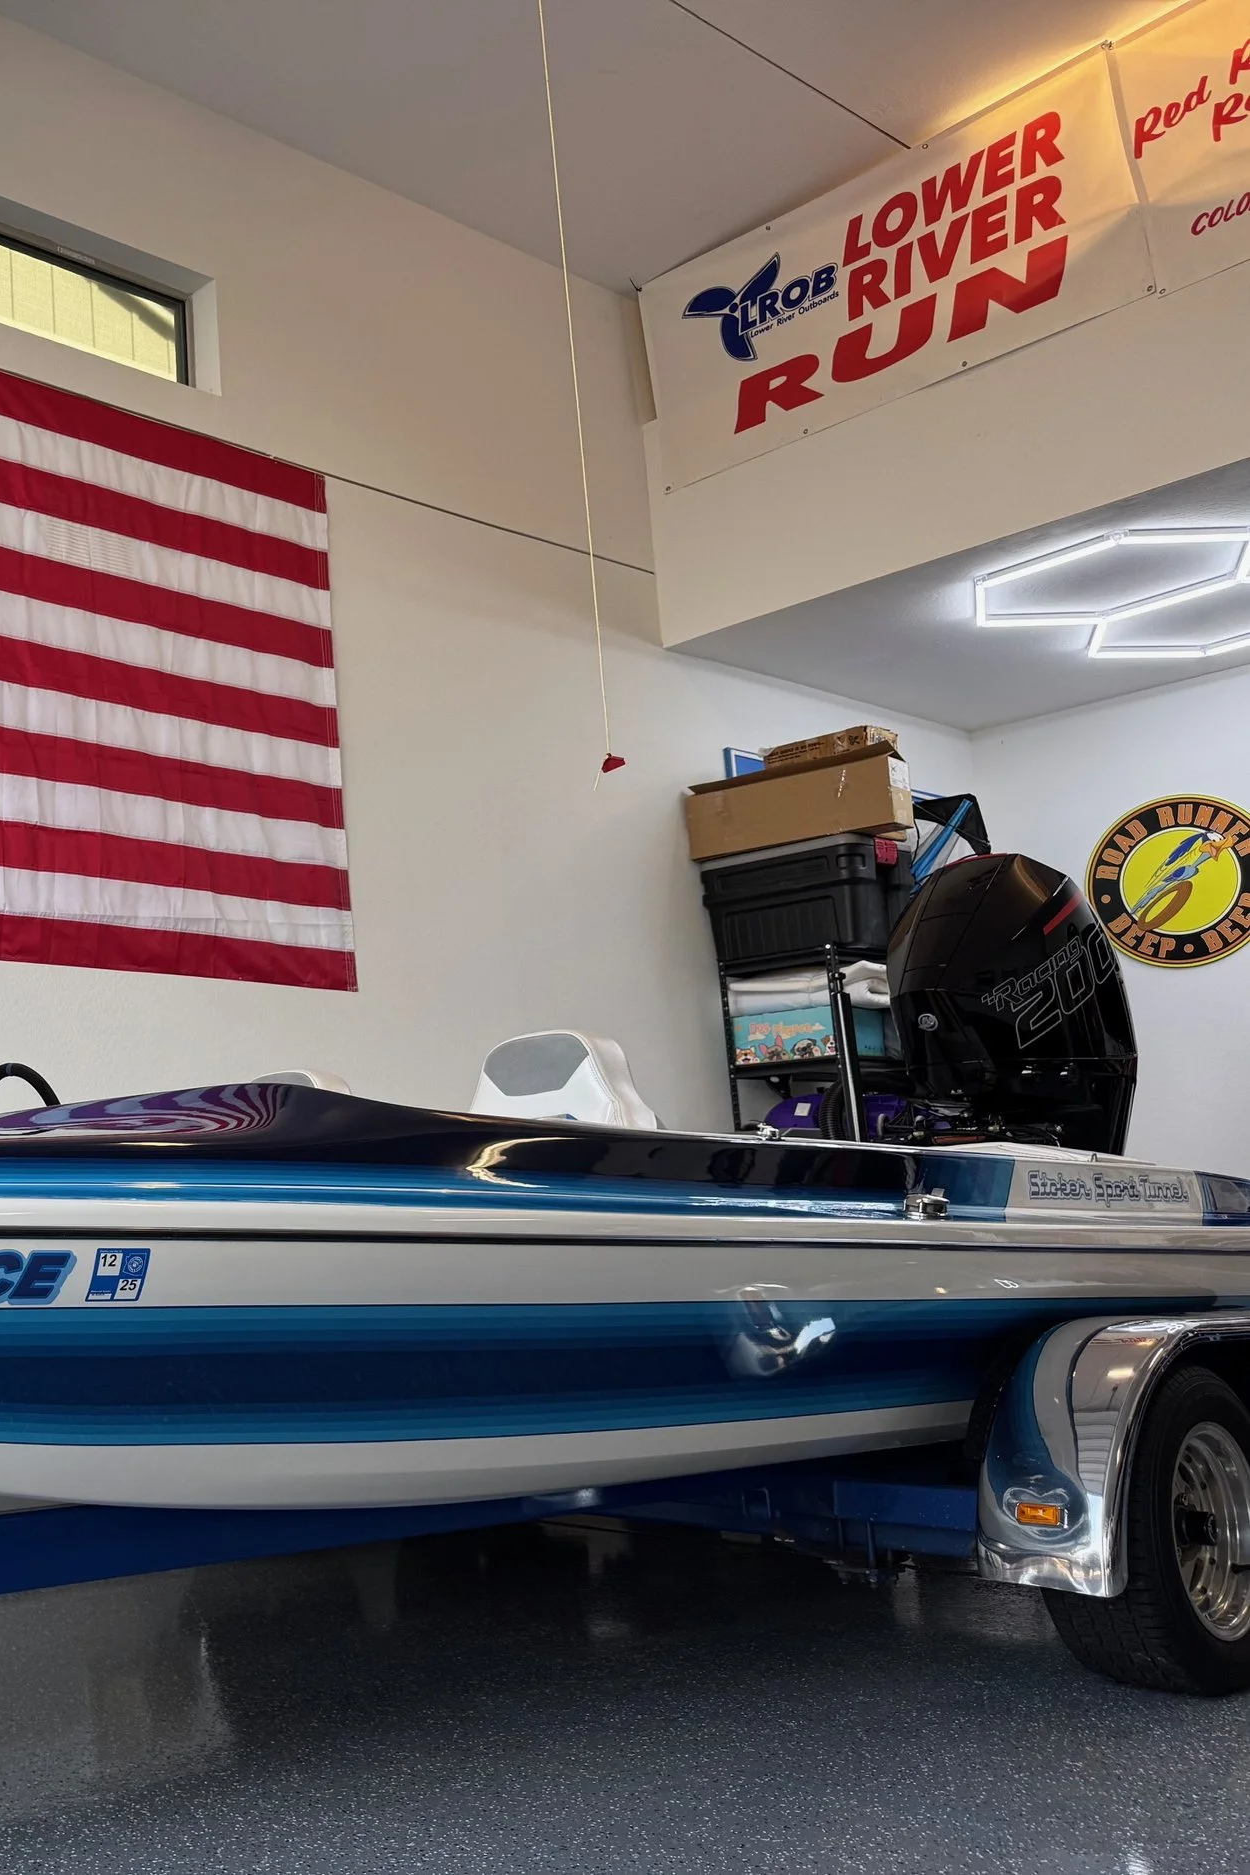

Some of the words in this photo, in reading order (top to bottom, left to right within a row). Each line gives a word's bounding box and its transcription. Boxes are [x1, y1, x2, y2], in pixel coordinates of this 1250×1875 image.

[1134, 75, 1212, 159] Red
[843, 111, 1065, 268] LOWER
[1191, 192, 1250, 236] COLO
[848, 175, 1066, 322] RIVER
[739, 263, 838, 335] LROB
[750, 324, 774, 338] Lower
[777, 313, 795, 327] River
[798, 290, 839, 315] Outboards
[734, 235, 1068, 434] RUN
[1096, 819, 1148, 880] ROAD
[1108, 913, 1176, 958] BEEP
[981, 935, 1083, 1011] Racing
[1011, 922, 1115, 1049] 200
[1027, 1170, 1092, 1200] Stoker
[1092, 1173, 1140, 1207] Sport
[1139, 1174, 1189, 1202] Tunnel
[101, 1254, 117, 1267] 12
[119, 1279, 138, 1291] 25
